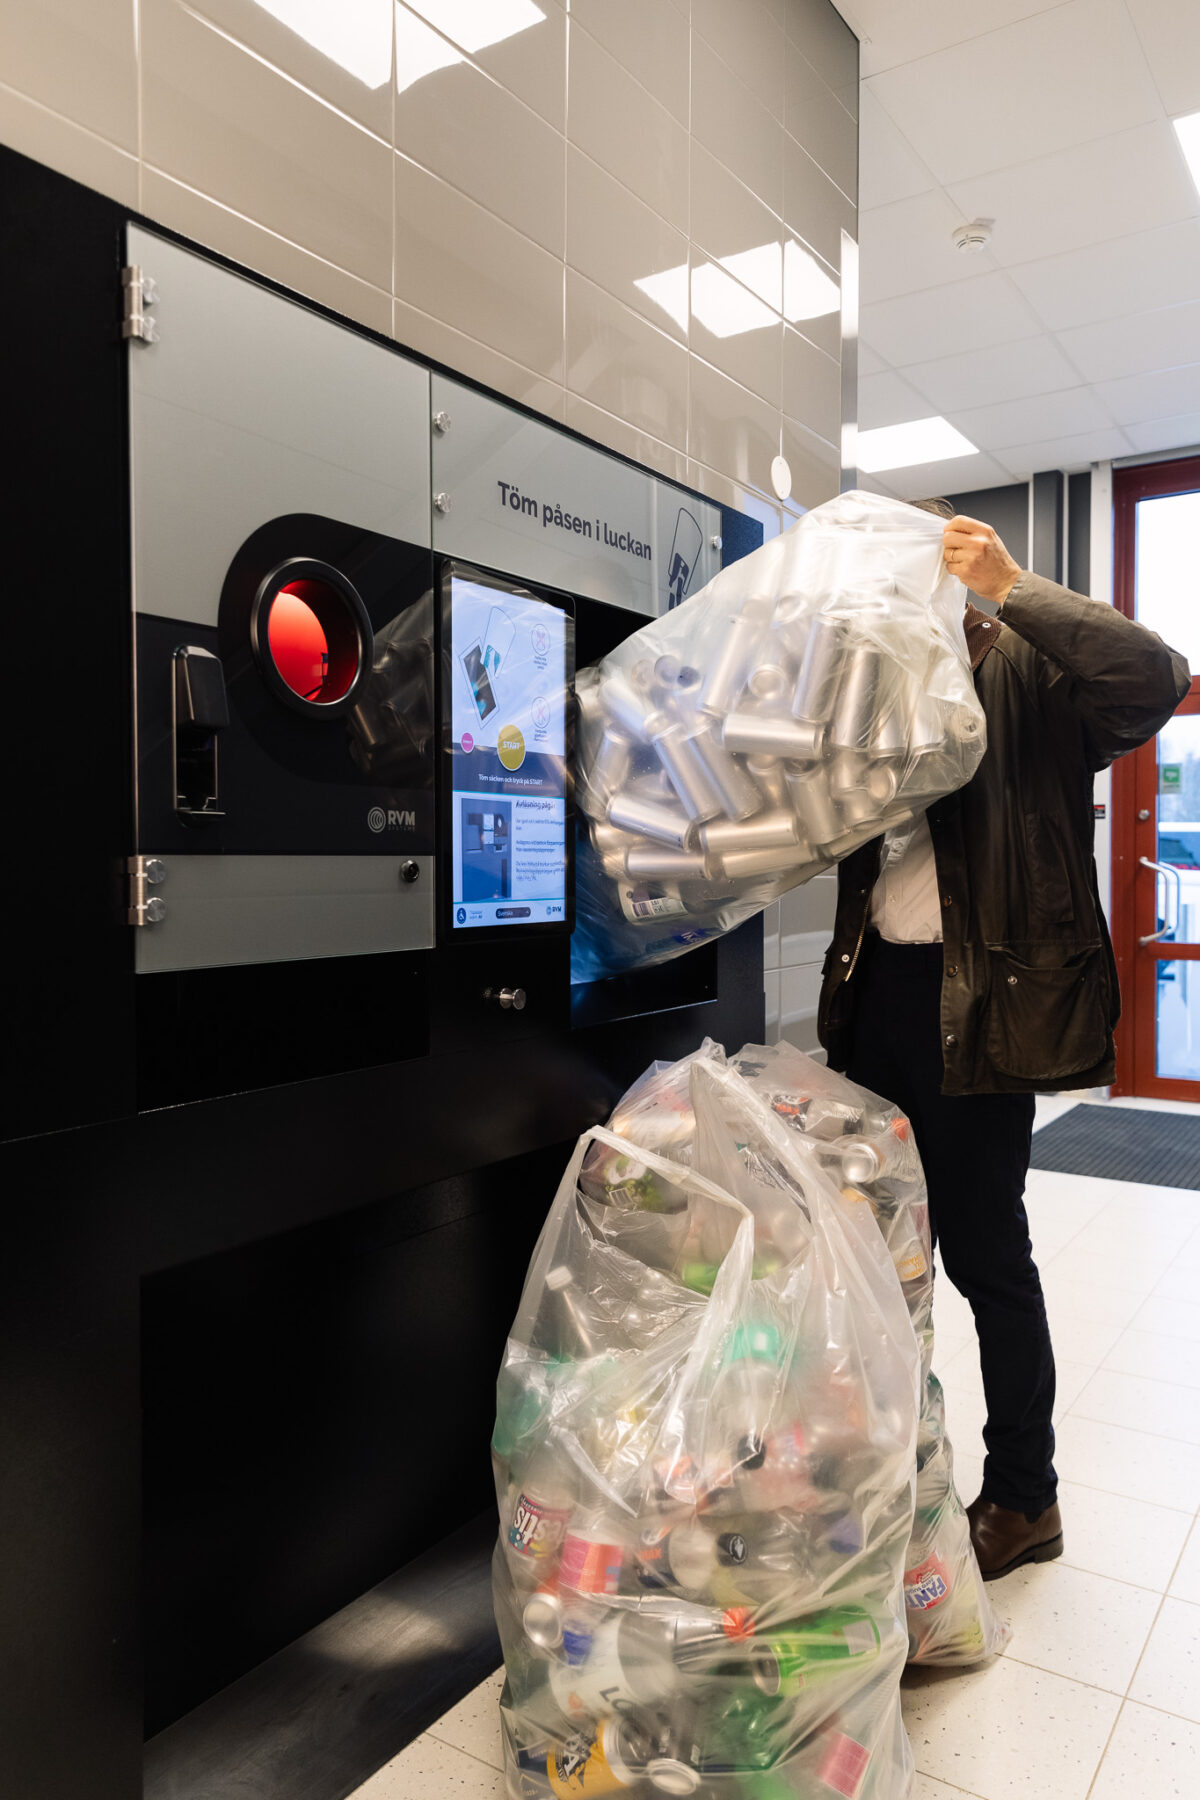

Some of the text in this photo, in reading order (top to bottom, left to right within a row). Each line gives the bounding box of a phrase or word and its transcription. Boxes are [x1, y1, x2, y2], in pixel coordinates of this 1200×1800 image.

[497, 480, 652, 561] Töm påsen i luckan
[502, 740, 521, 750] START
[478, 773, 489, 781] Töm
[387, 809, 416, 826] RVM
[906, 1576, 946, 1608] FANT
